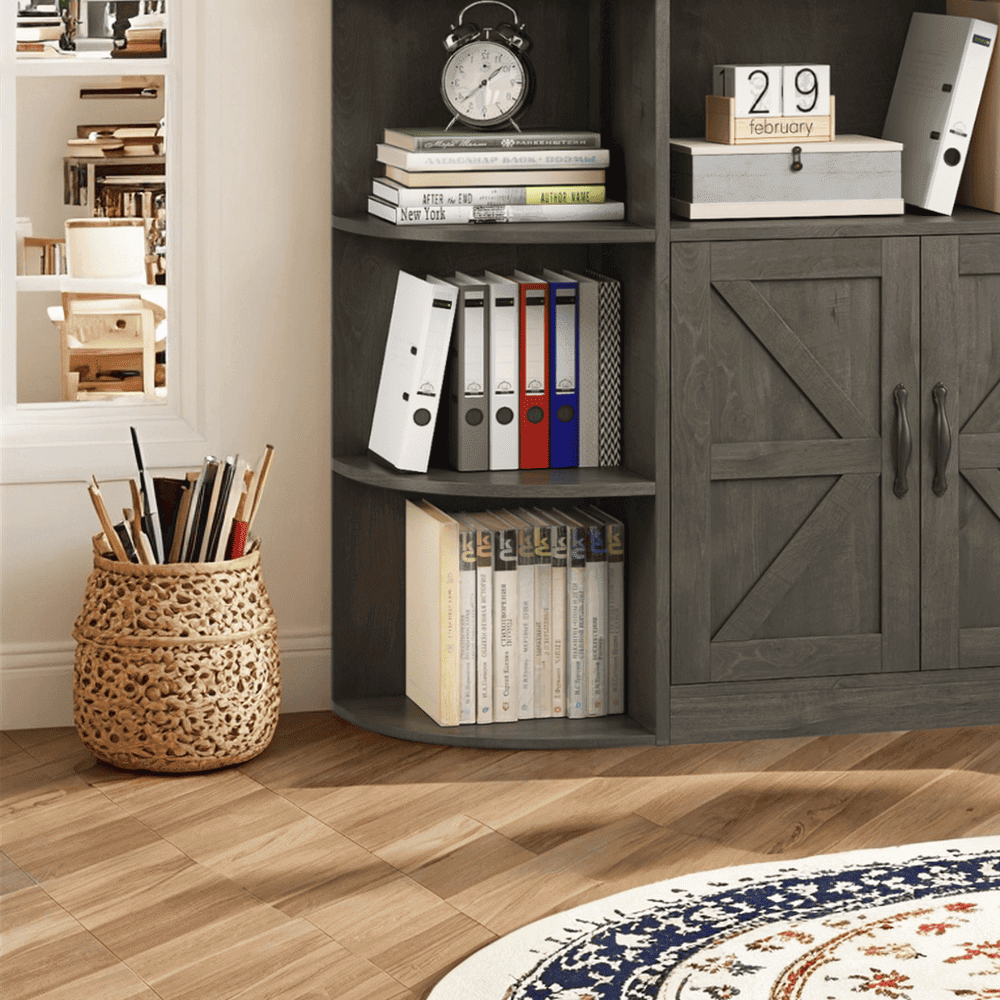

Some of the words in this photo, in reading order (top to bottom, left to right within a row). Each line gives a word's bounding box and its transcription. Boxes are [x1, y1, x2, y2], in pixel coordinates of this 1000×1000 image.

[749, 119, 813, 137] february
[424, 156, 498, 164] АЛЕКСАНДР
[422, 193, 444, 205] AFTER
[540, 192, 567, 203] AUTHOR
[571, 191, 590, 203] NAME
[400, 208, 422, 222] New
[423, 206, 446, 221] York
